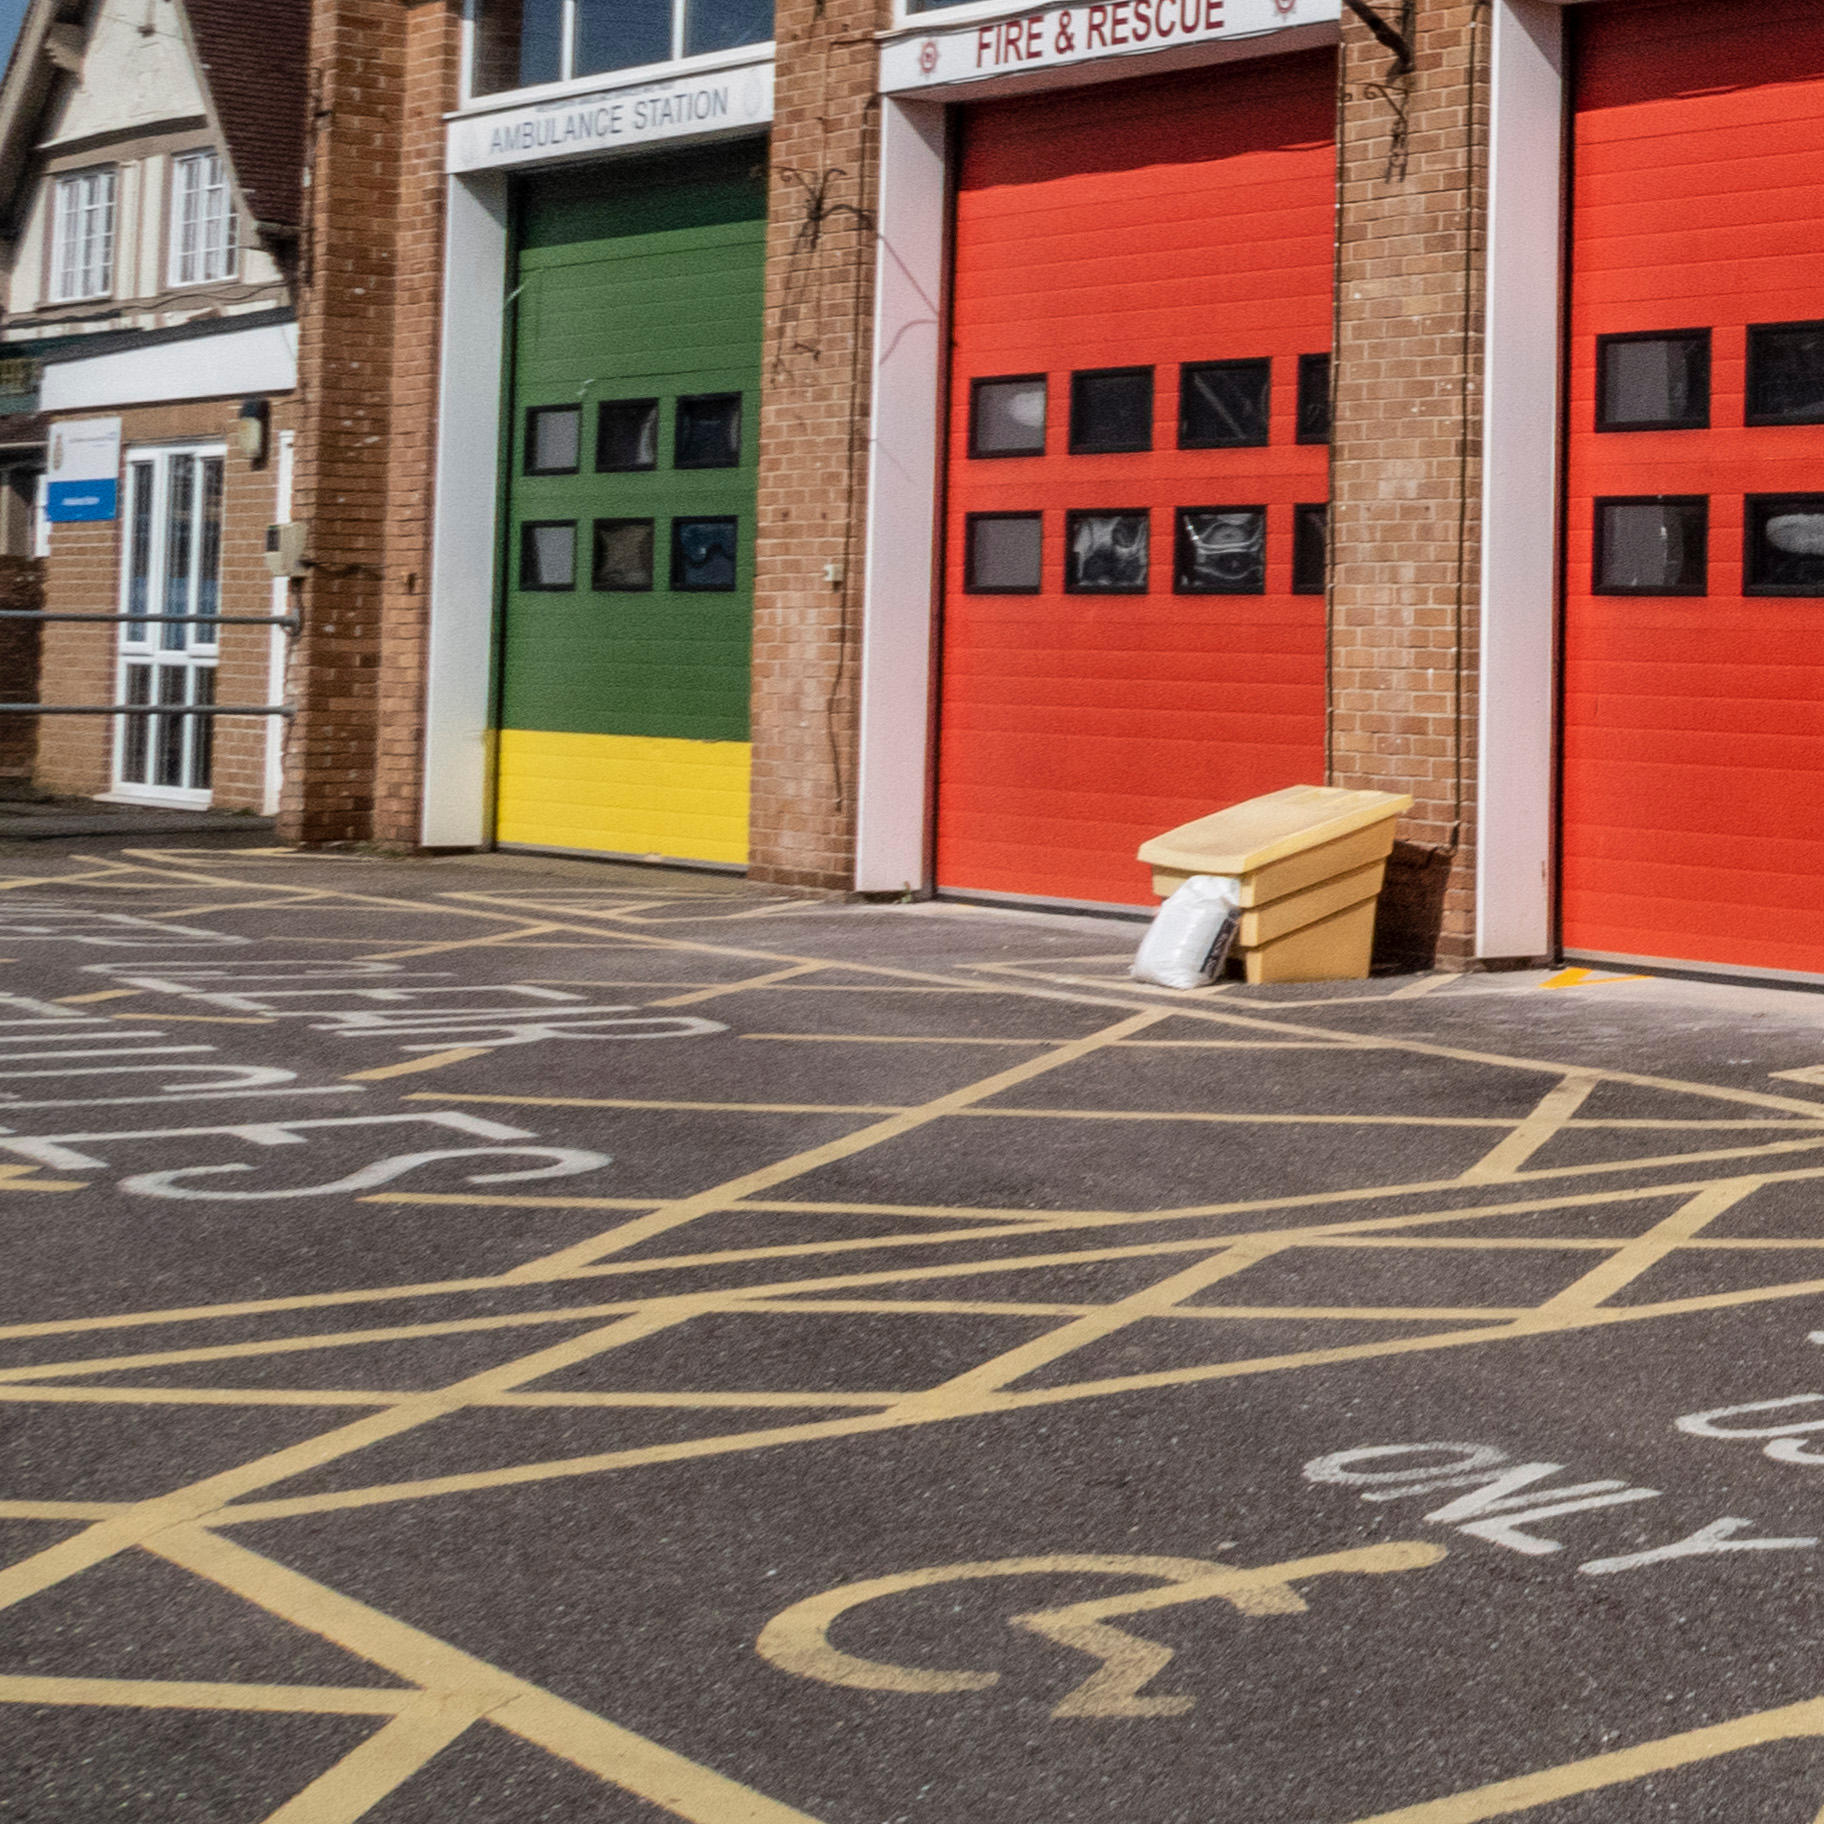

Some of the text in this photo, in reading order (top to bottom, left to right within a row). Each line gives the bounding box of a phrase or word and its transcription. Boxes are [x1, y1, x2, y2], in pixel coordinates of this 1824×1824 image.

[977, 16, 1044, 68] FIRE
[1055, 10, 1075, 55] &
[490, 105, 624, 154] AMBULANCE
[633, 87, 729, 130] STATION
[78, 959, 731, 1052] CLEAR
[1299, 1439, 1820, 1575] ONLY
